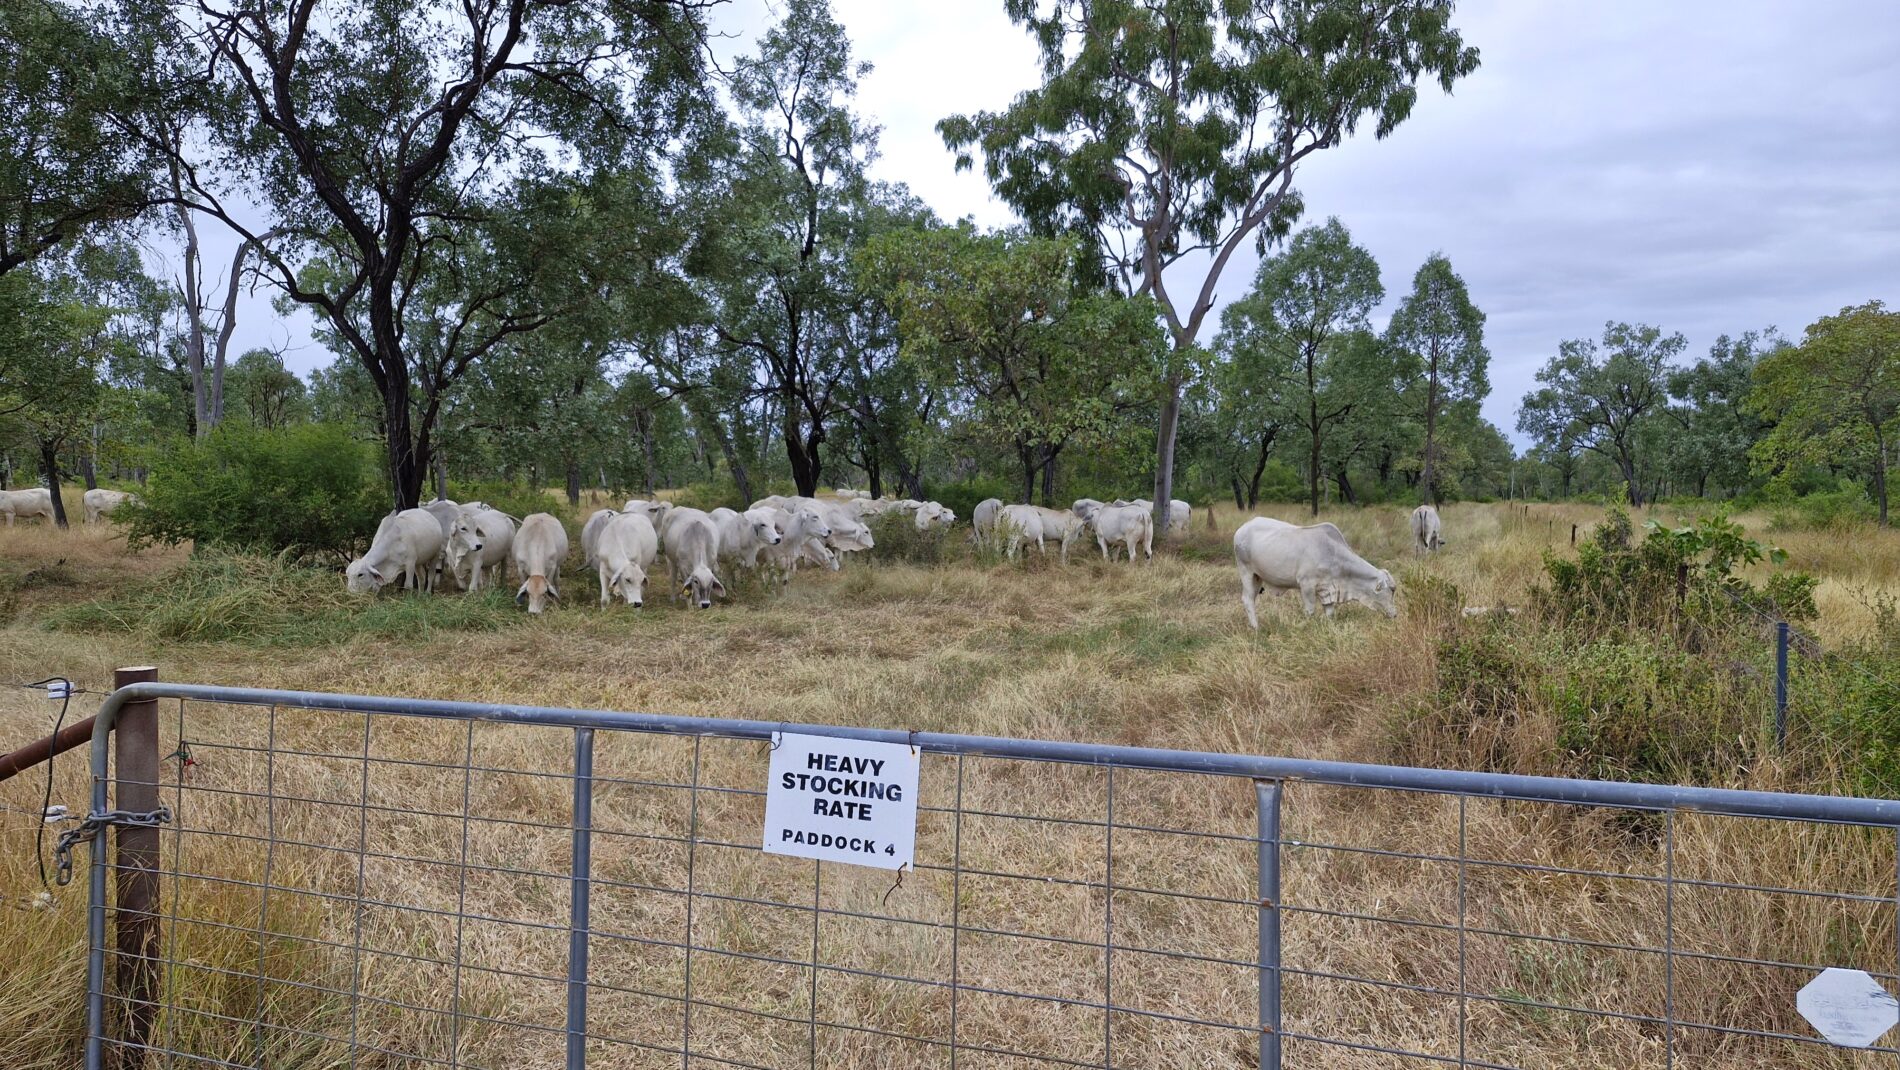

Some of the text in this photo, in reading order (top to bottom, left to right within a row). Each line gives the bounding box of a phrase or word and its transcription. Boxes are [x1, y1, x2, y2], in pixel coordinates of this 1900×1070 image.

[807, 752, 885, 776] HEAVY
[782, 772, 902, 802] STOCKING
[813, 798, 872, 821] RATE
[782, 829, 896, 857] PADDOCK 4
